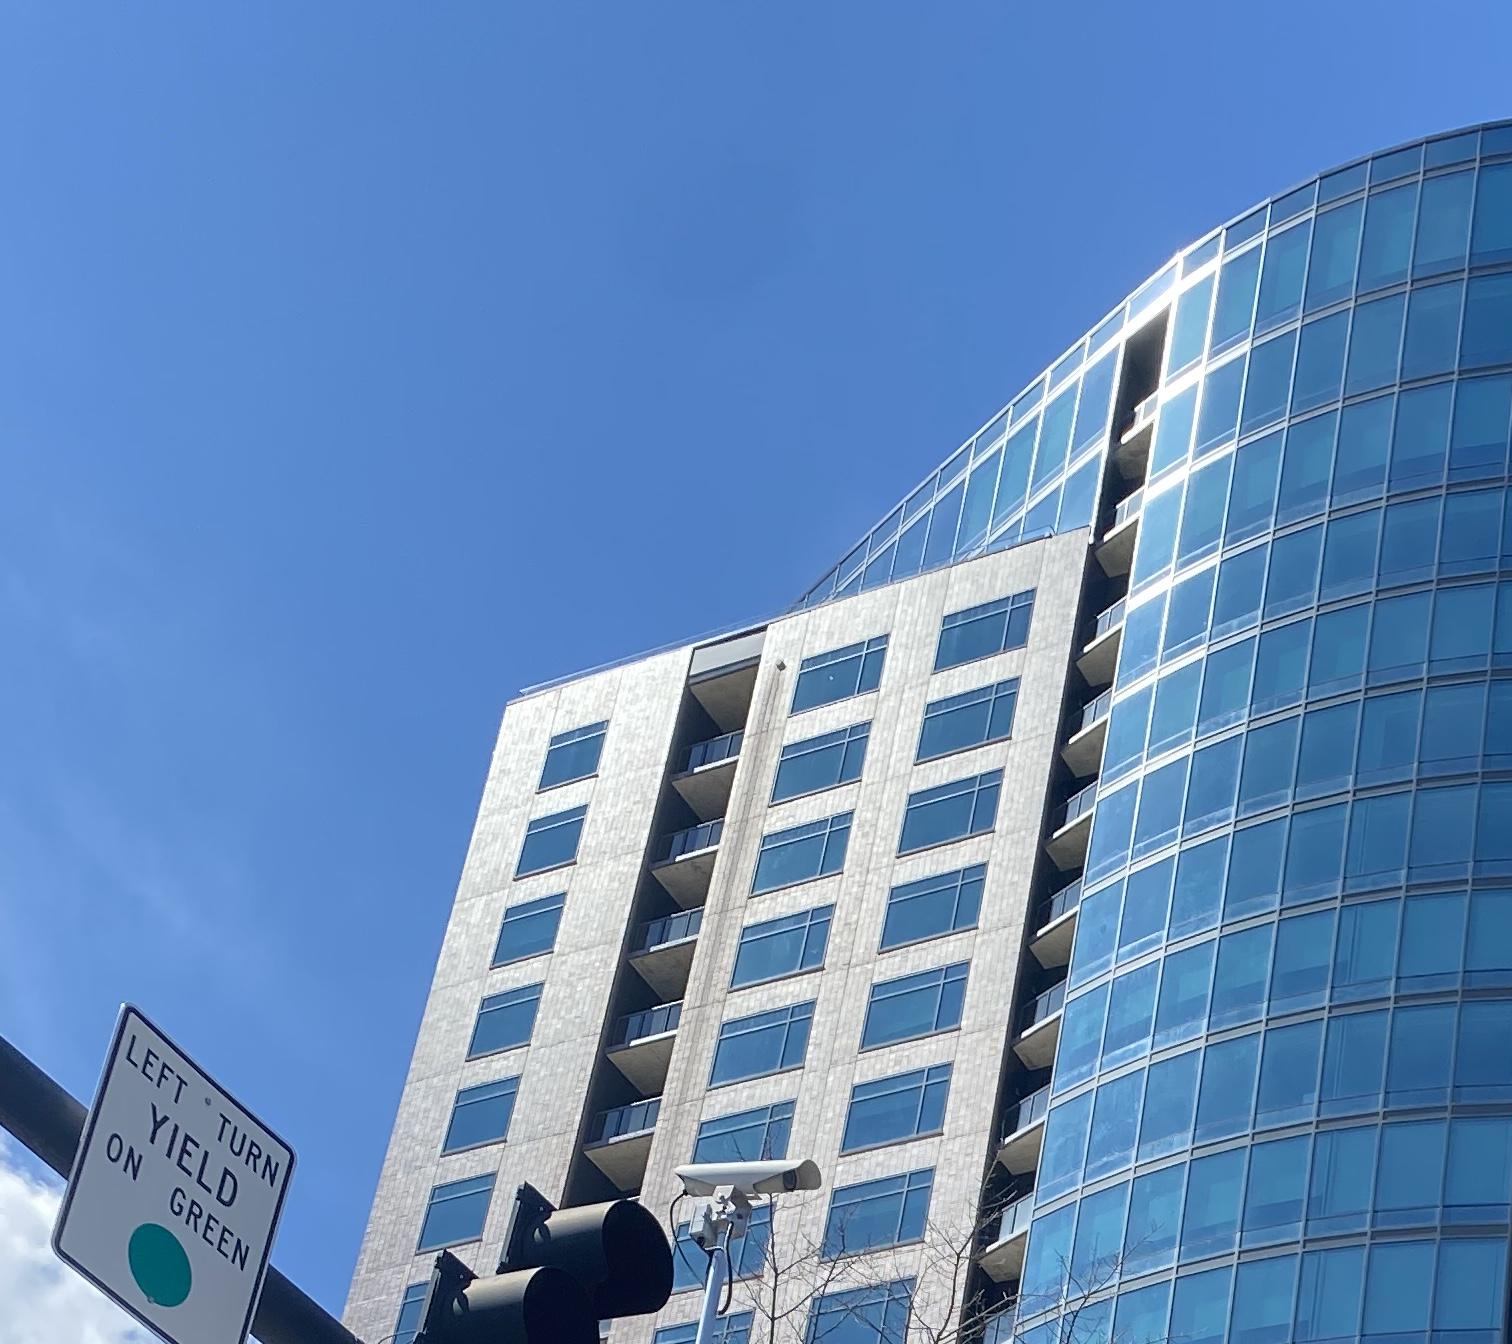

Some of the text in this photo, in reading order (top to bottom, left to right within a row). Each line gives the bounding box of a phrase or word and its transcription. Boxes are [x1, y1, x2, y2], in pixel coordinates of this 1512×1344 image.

[126, 1034, 280, 1187] LEFT TURN
[149, 1101, 238, 1207] YIELD
[106, 1132, 250, 1272] ON GREEN
